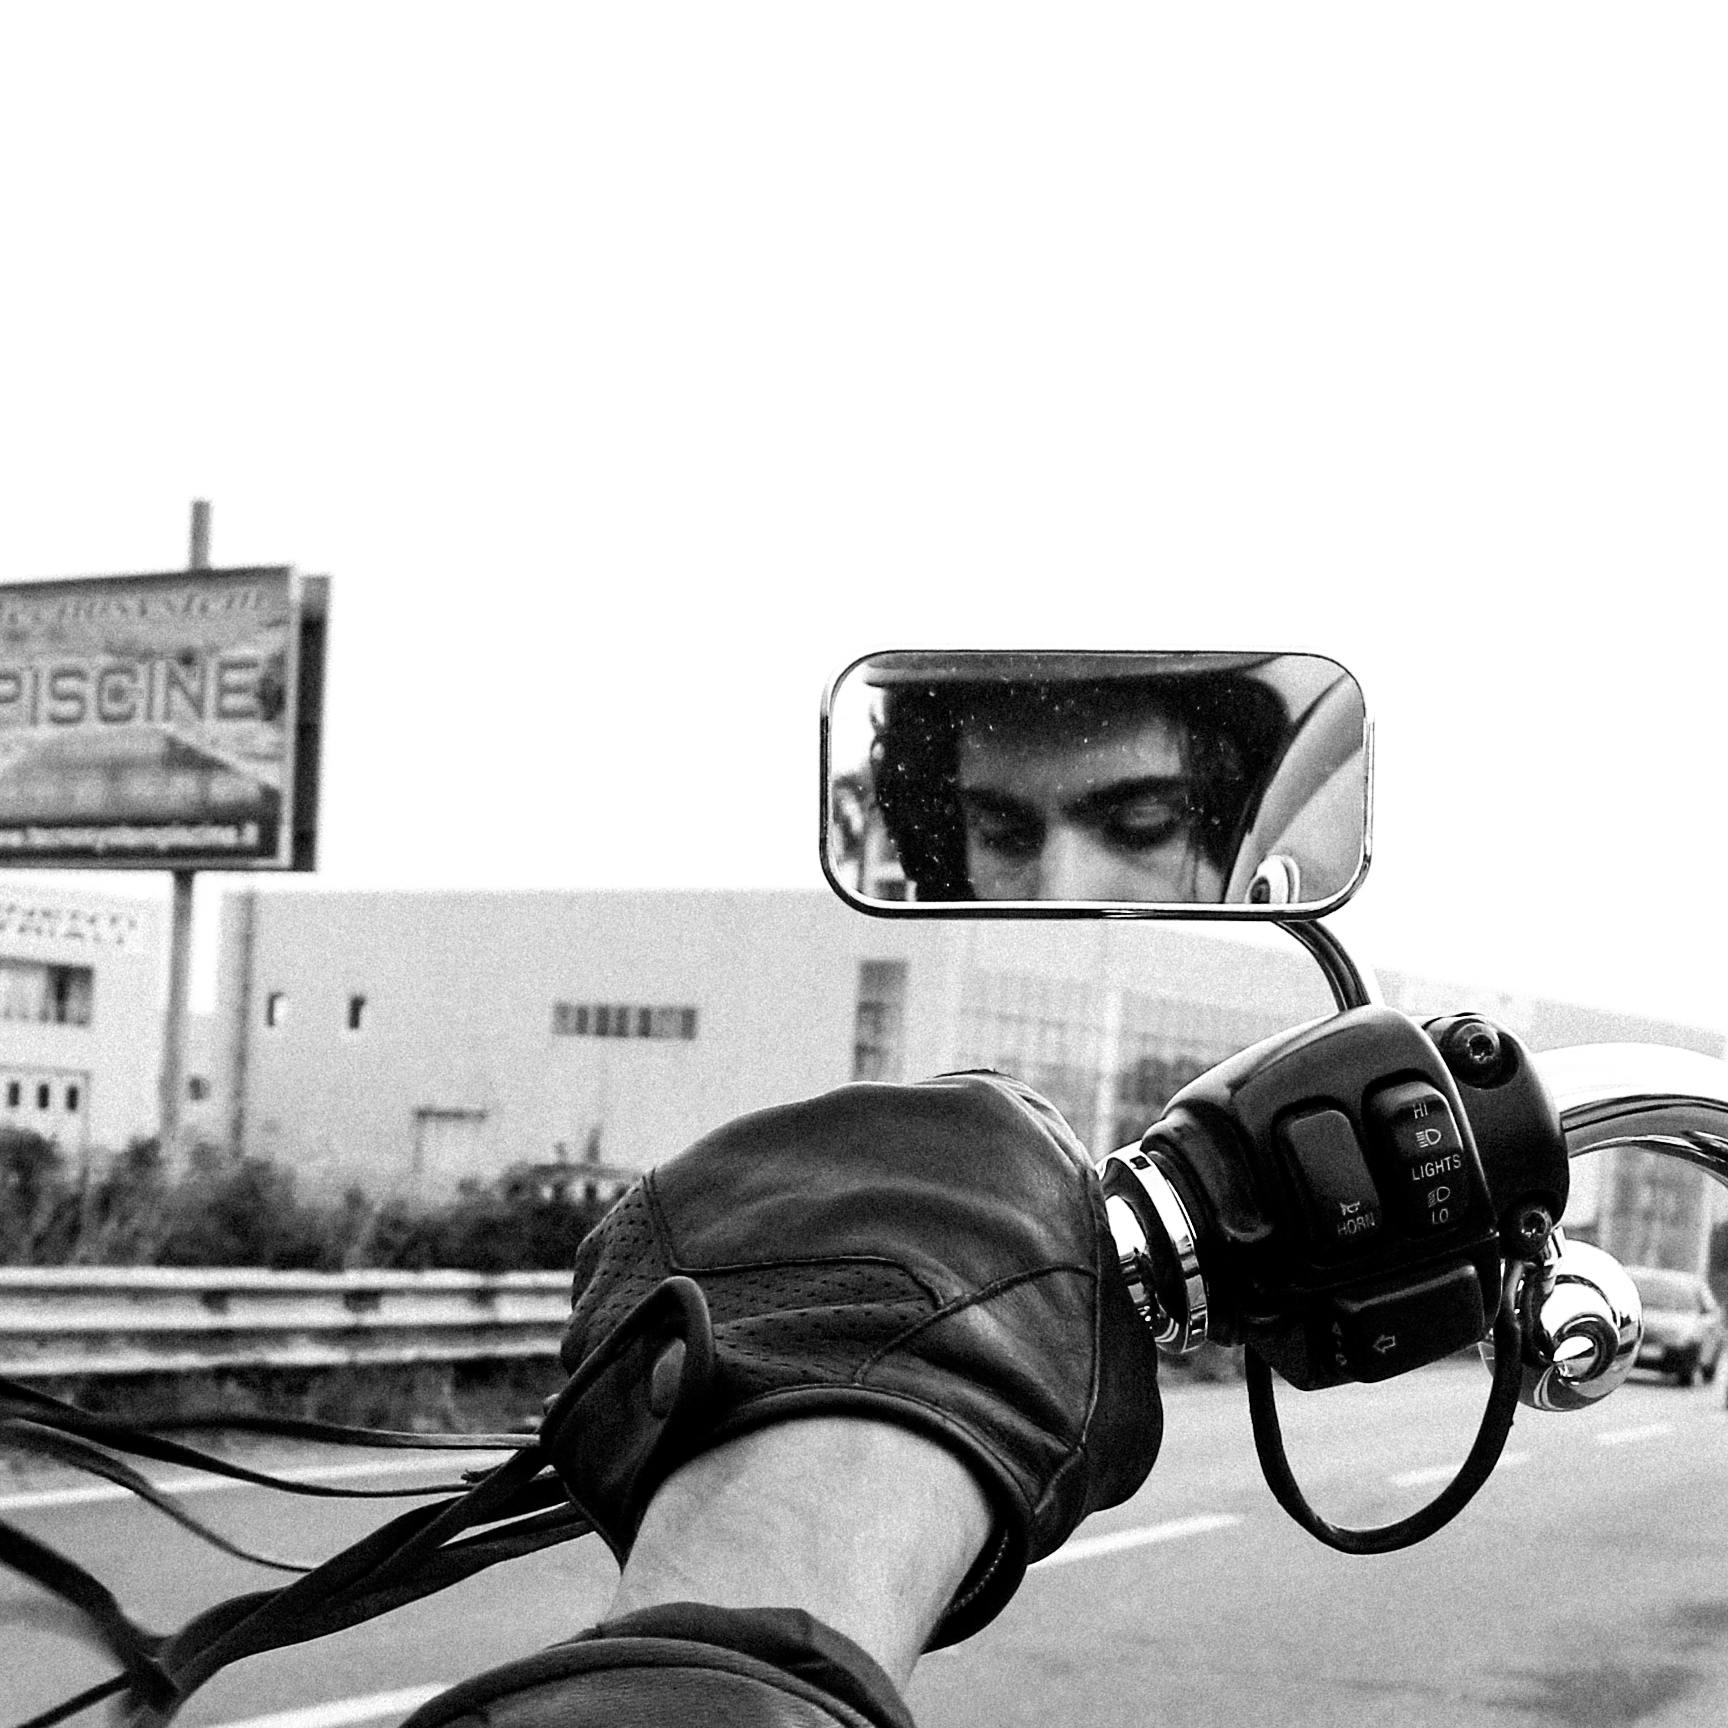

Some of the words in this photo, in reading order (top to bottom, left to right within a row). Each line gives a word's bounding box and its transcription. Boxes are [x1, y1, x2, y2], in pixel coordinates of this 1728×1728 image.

[1412, 1102, 1429, 1119] HI
[1411, 1153, 1462, 1181] LIGHTS
[1336, 1212, 1376, 1236] HORN
[1431, 1207, 1449, 1225] LO
